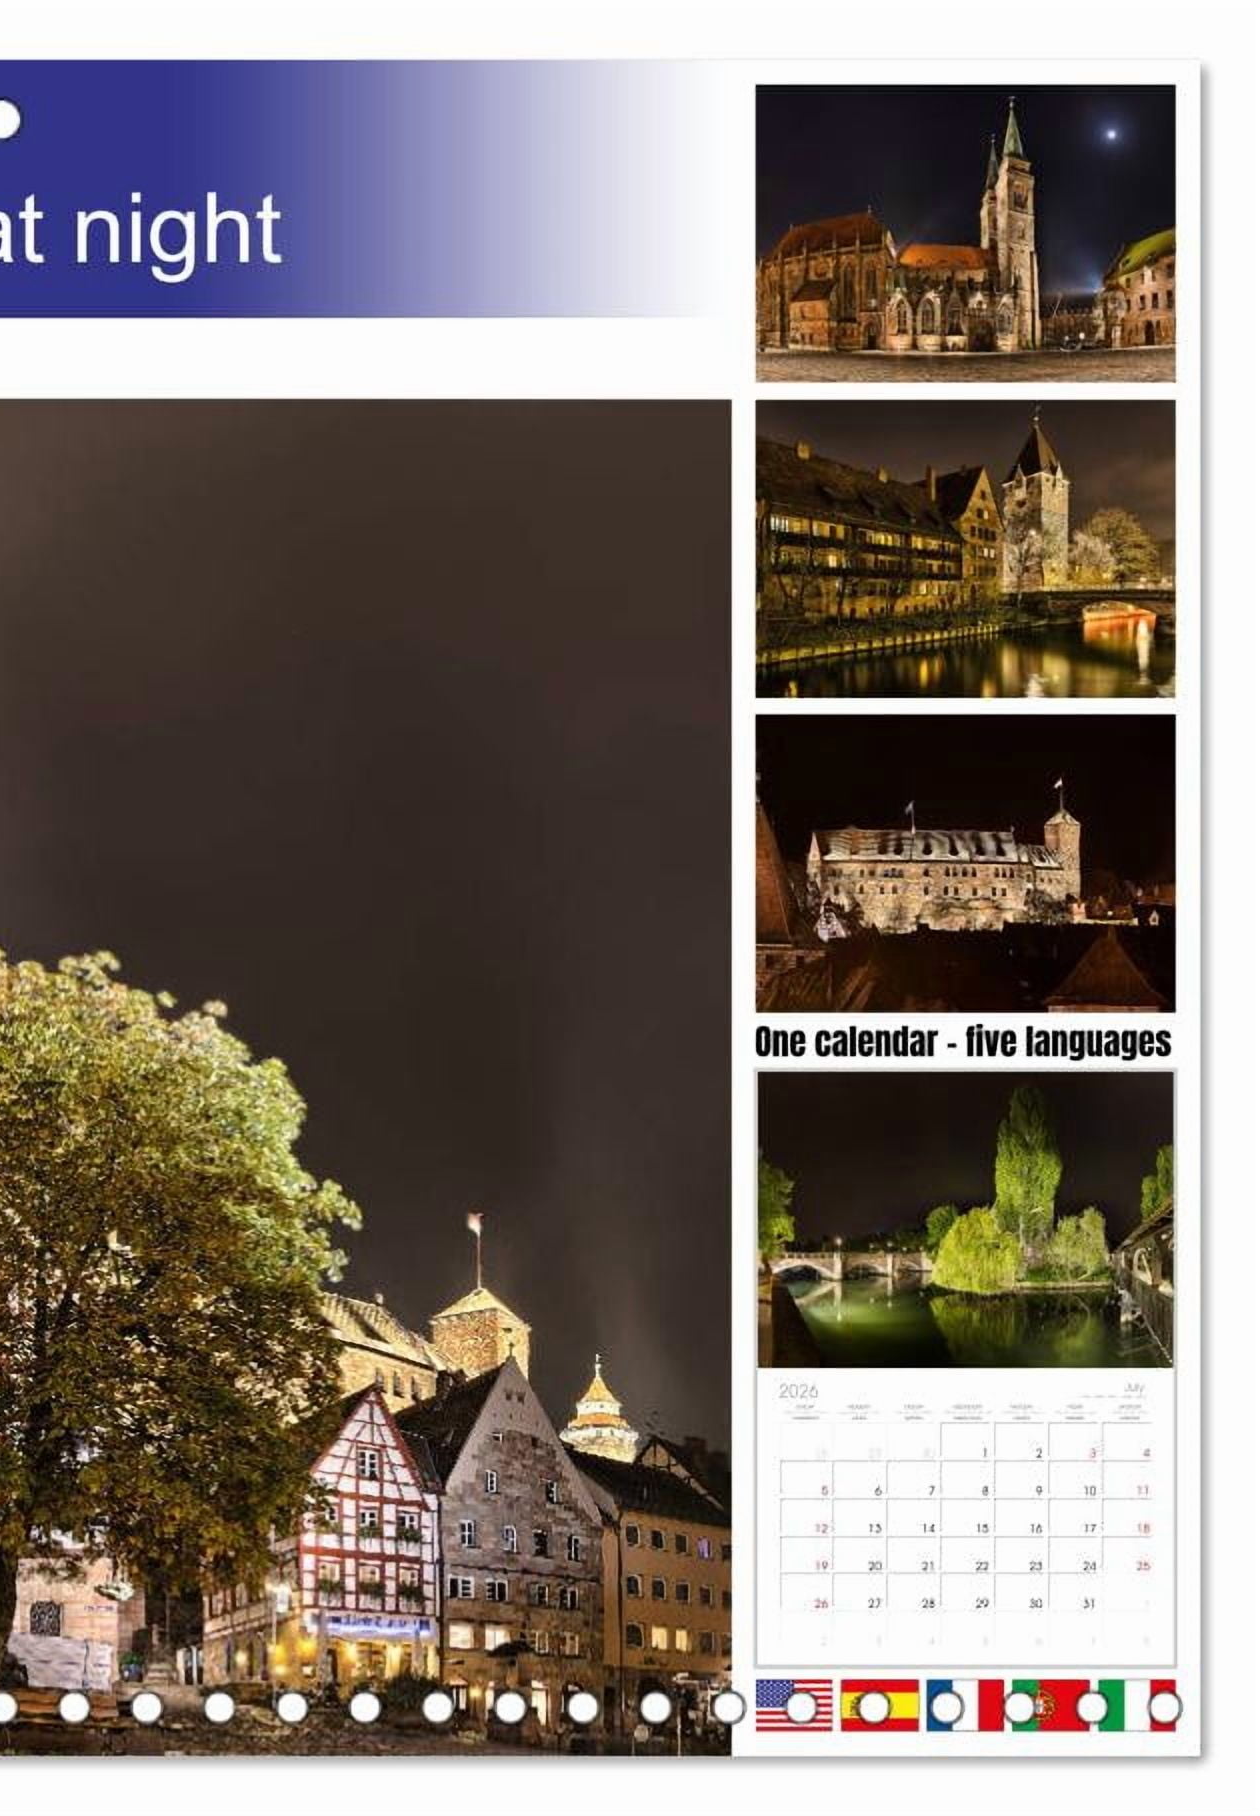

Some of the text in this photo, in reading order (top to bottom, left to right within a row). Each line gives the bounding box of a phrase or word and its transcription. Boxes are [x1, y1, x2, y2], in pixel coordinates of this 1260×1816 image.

[77, 191, 282, 283] night
[755, 1025, 806, 1057] One
[814, 1025, 939, 1058] calendar
[965, 1023, 1017, 1058] five
[1025, 1025, 1172, 1062] languages
[778, 1383, 819, 1399] 2026
[1124, 1382, 1146, 1395] July
[982, 1448, 1151, 1459] 1 2 3 4
[874, 1485, 883, 1497] 6
[928, 1485, 936, 1497] 7
[981, 1485, 989, 1497] 8
[1035, 1485, 1043, 1497] 9
[1083, 1485, 1097, 1497] 10
[1137, 1485, 1149, 1497] 11
[816, 1523, 829, 1534] 12
[869, 1523, 883, 1534] 13
[922, 1523, 936, 1534] 14
[976, 1523, 989, 1534] 15
[1030, 1523, 1043, 1534] 16
[1084, 1523, 1097, 1534] 17
[816, 1561, 829, 1572] 19
[868, 1561, 883, 1572] 20
[921, 1561, 935, 1572] 21
[975, 1561, 989, 1572] 22
[1029, 1561, 1043, 1572] 23
[1083, 1561, 1097, 1572] 24
[814, 1598, 1096, 1609] 26 27 28 29 30 31
